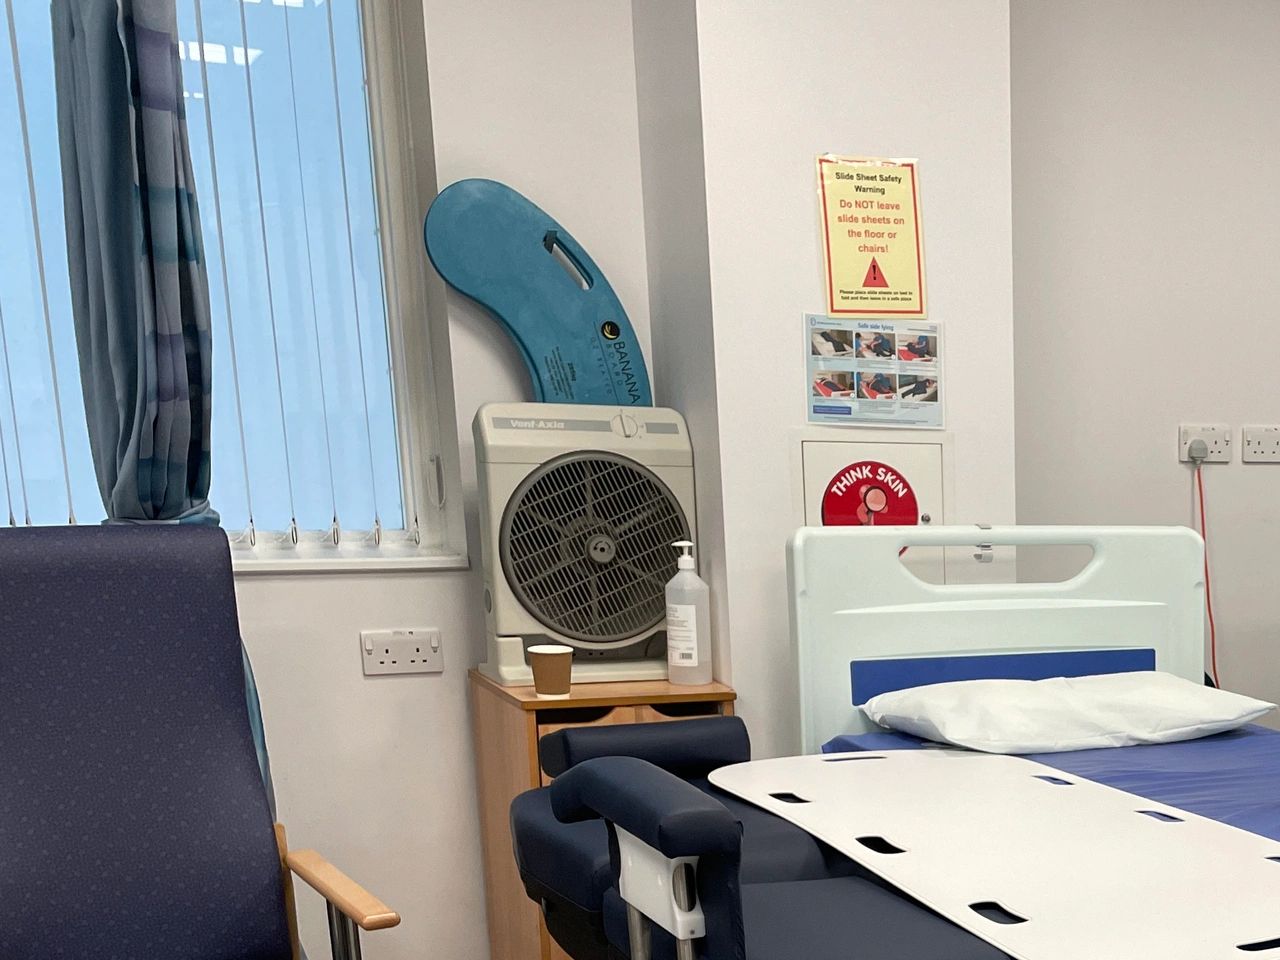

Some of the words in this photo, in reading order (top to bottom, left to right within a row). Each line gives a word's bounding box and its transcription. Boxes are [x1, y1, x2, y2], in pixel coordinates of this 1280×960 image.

[835, 172, 854, 180] Slide
[856, 173, 877, 181] Sheet
[879, 174, 902, 183] Safety
[854, 185, 885, 195] Warning
[839, 199, 852, 208] Do
[855, 200, 875, 209] NOT
[877, 201, 900, 210] leave
[837, 214, 859, 223] slide
[861, 215, 891, 225] sheets
[893, 217, 905, 225] on
[847, 229, 862, 238] the
[864, 230, 885, 239] floor
[858, 244, 889, 253] chairs!
[606, 343, 623, 386] BOARD
[613, 341, 640, 404] BANANA
[510, 419, 565, 429] Vent-Axia
[831, 465, 874, 497] THINK
[876, 467, 908, 498] SKIN
